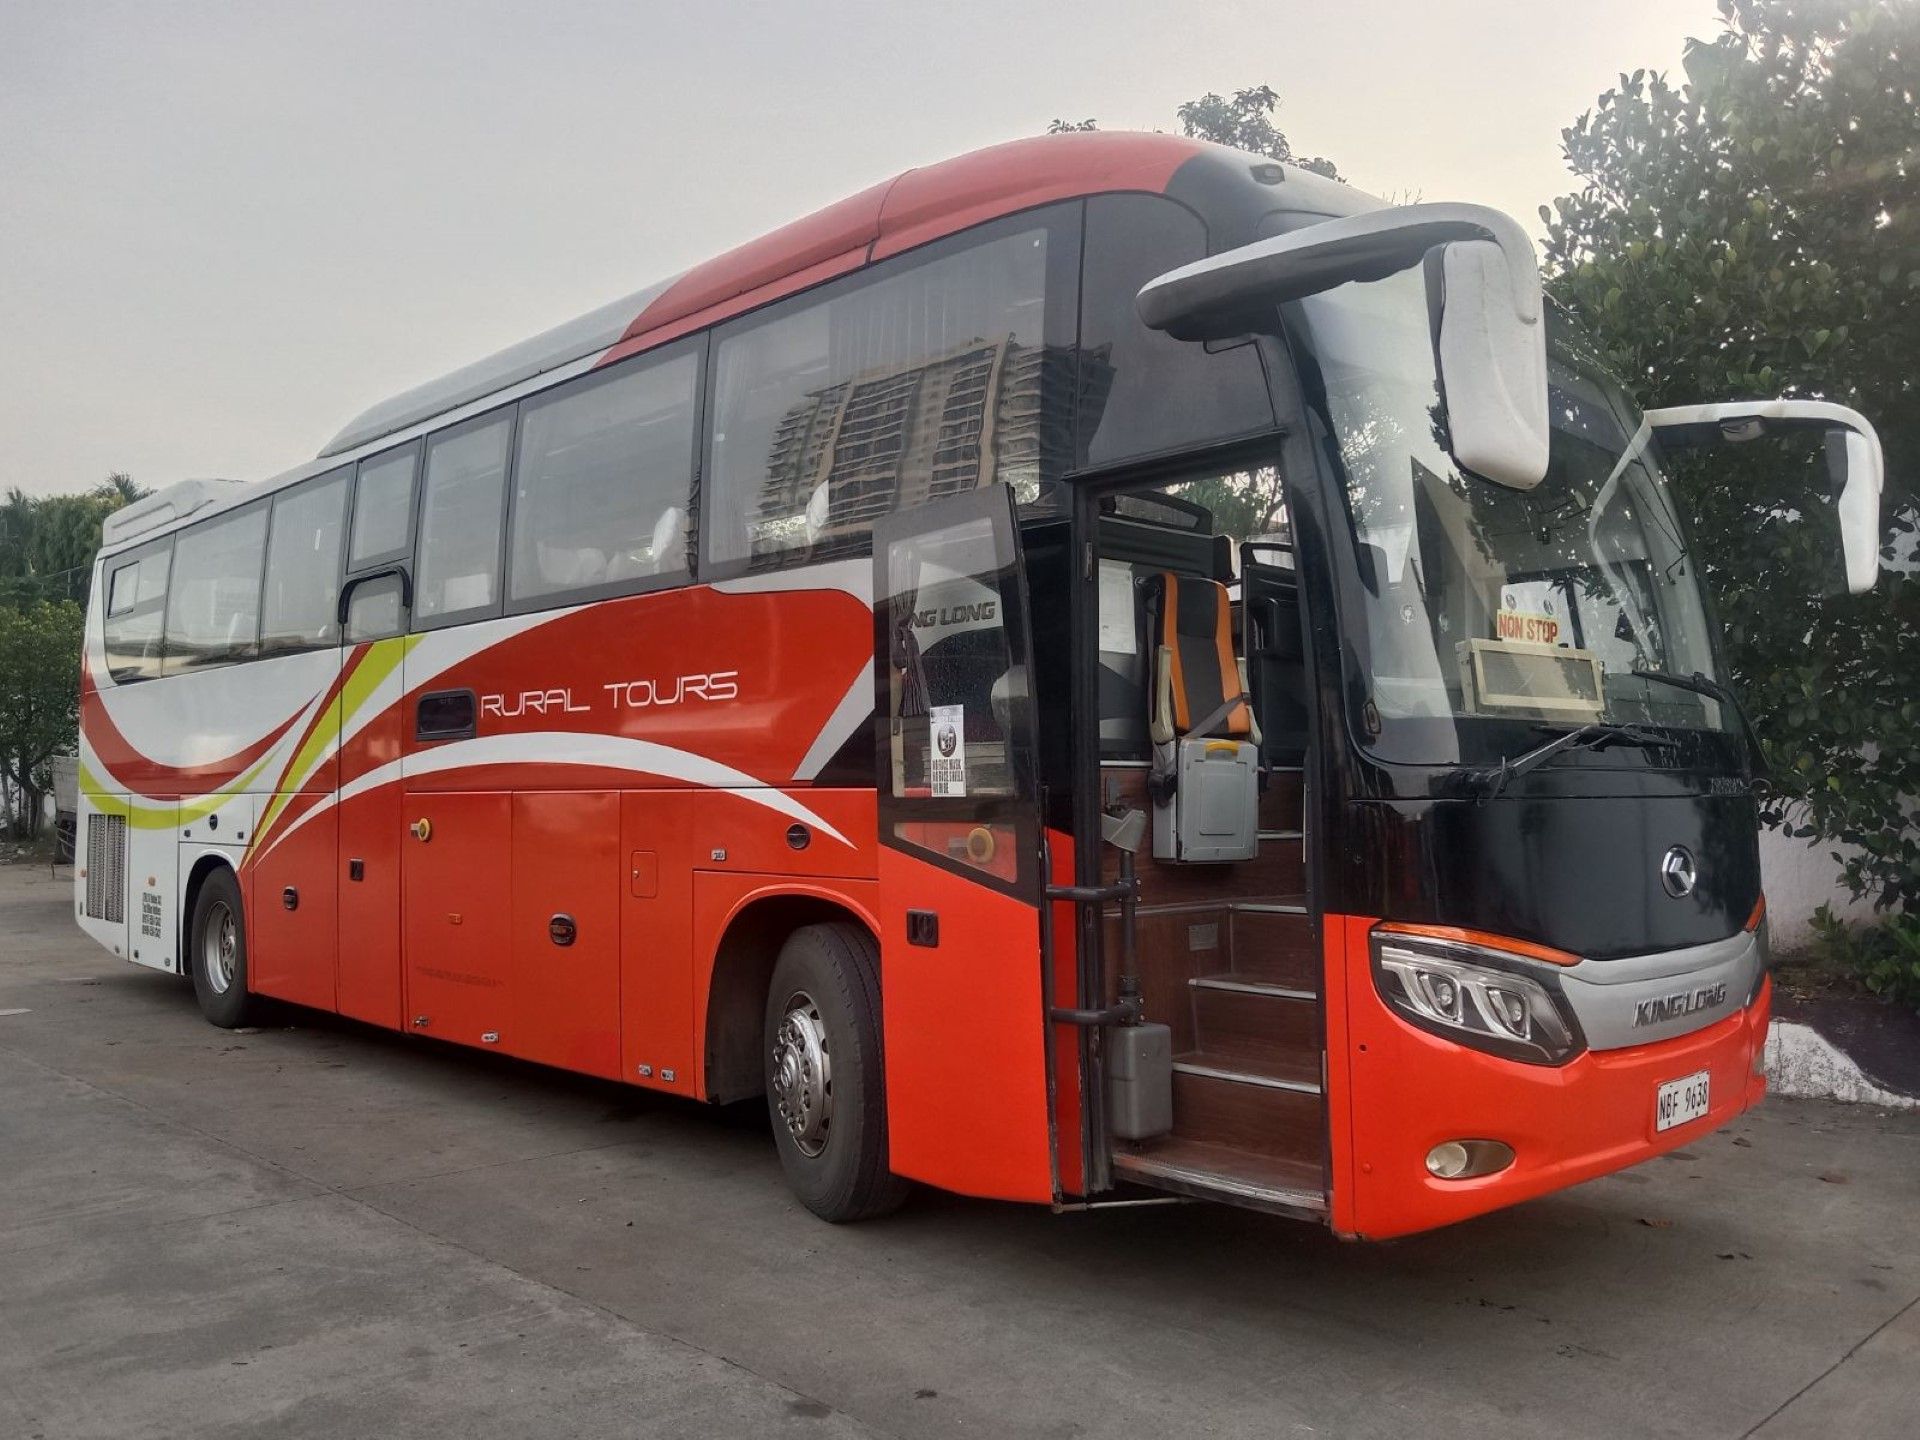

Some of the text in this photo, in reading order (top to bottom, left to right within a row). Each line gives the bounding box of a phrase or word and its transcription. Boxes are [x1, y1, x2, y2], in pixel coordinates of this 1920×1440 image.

[940, 601, 996, 626] LONG
[1499, 614, 1558, 643] NON STOP
[480, 671, 738, 718] RURAL TOURS
[1659, 1080, 1708, 1121] NBF 9638
